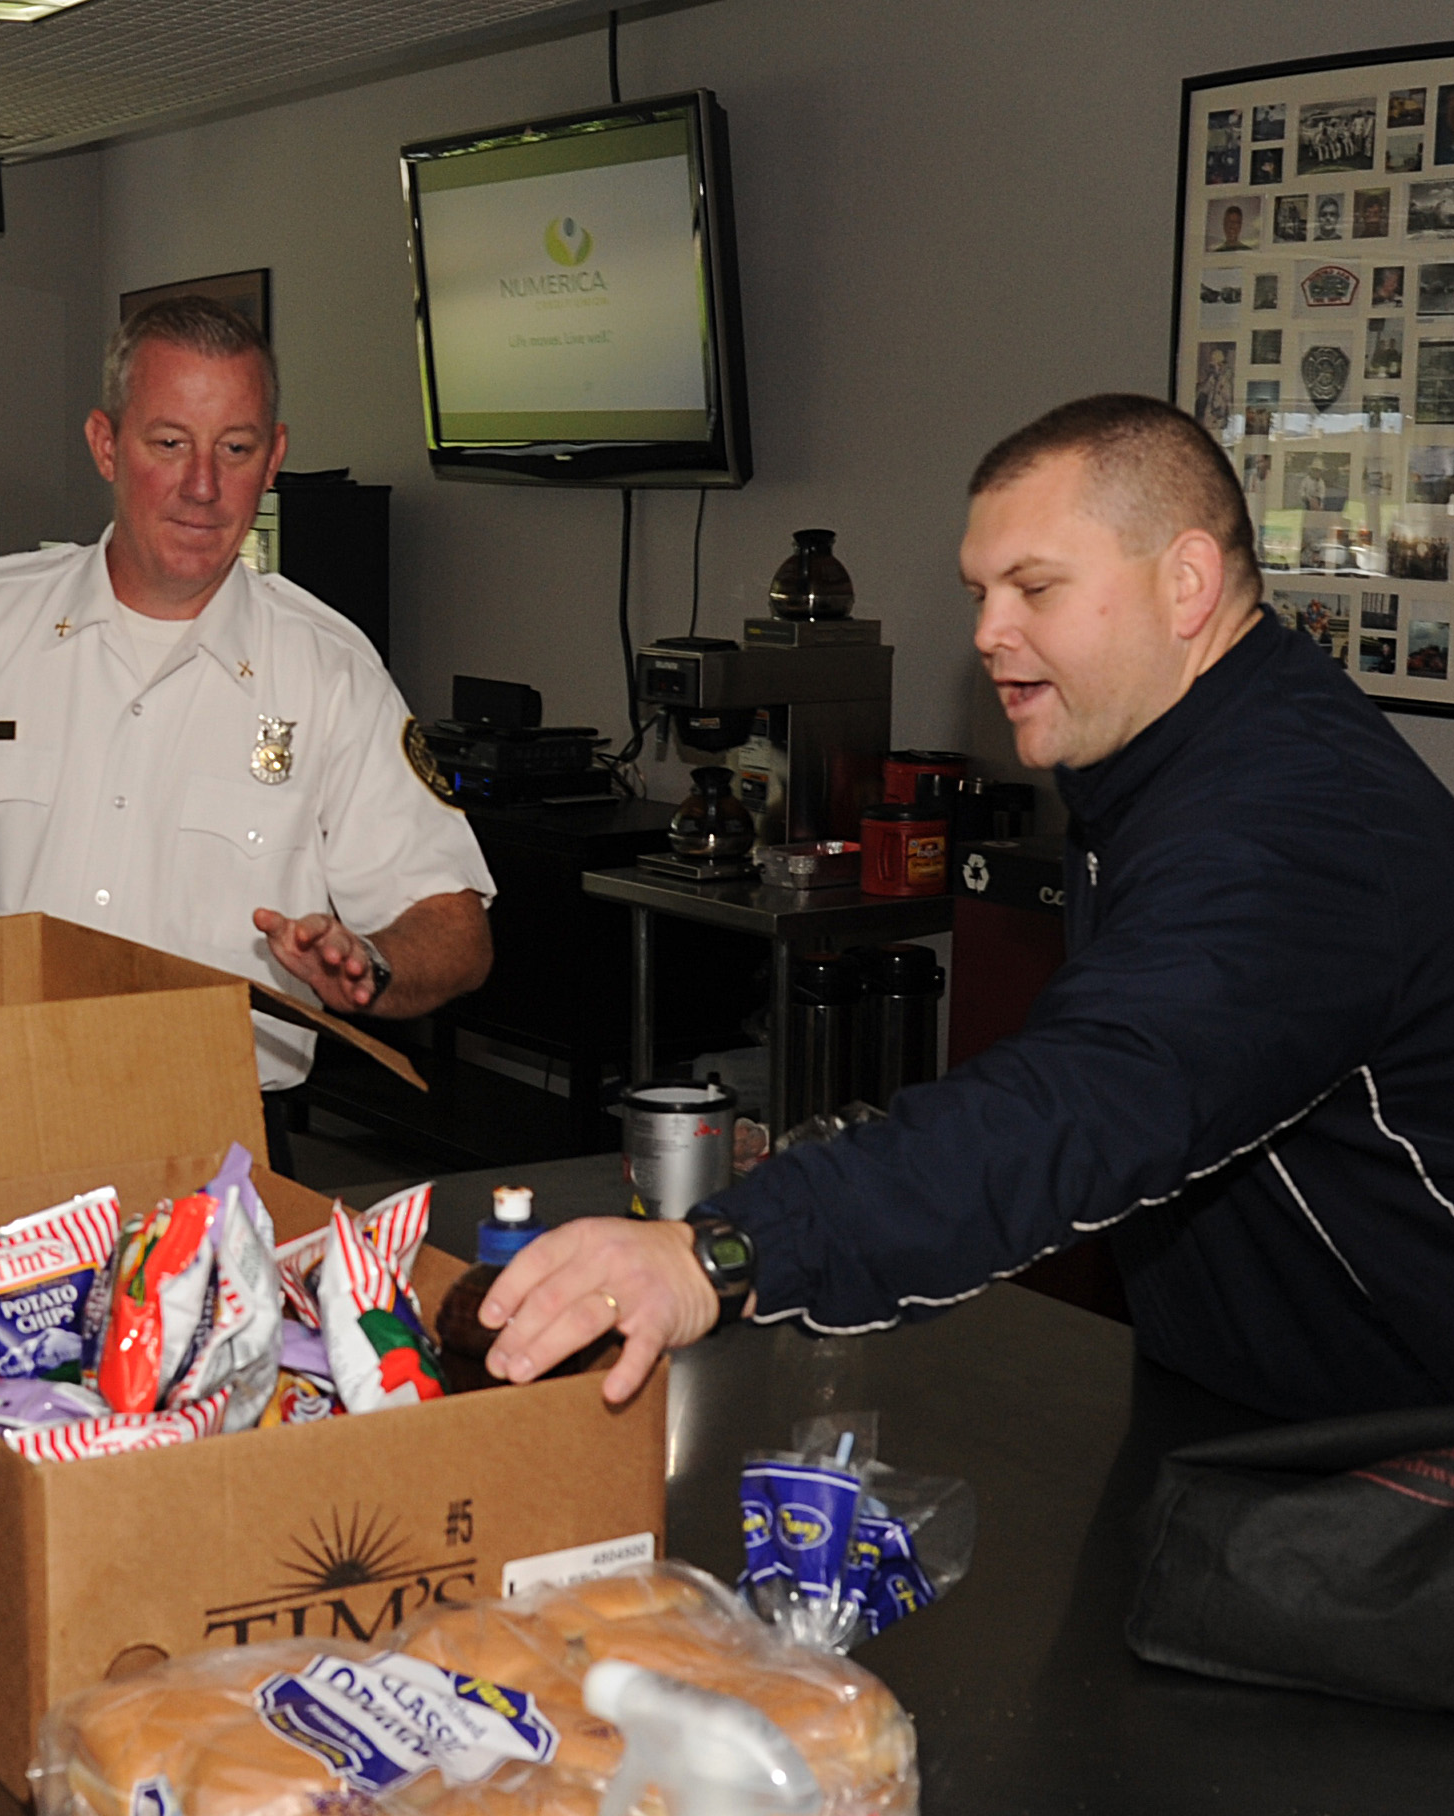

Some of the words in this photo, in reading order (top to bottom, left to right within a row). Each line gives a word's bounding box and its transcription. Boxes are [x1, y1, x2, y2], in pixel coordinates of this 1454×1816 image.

[499, 270, 608, 298] NUMERICA
[0, 1284, 78, 1319] POTATO
[15, 1303, 75, 1334] CHIPS
[445, 1499, 474, 1547] #5
